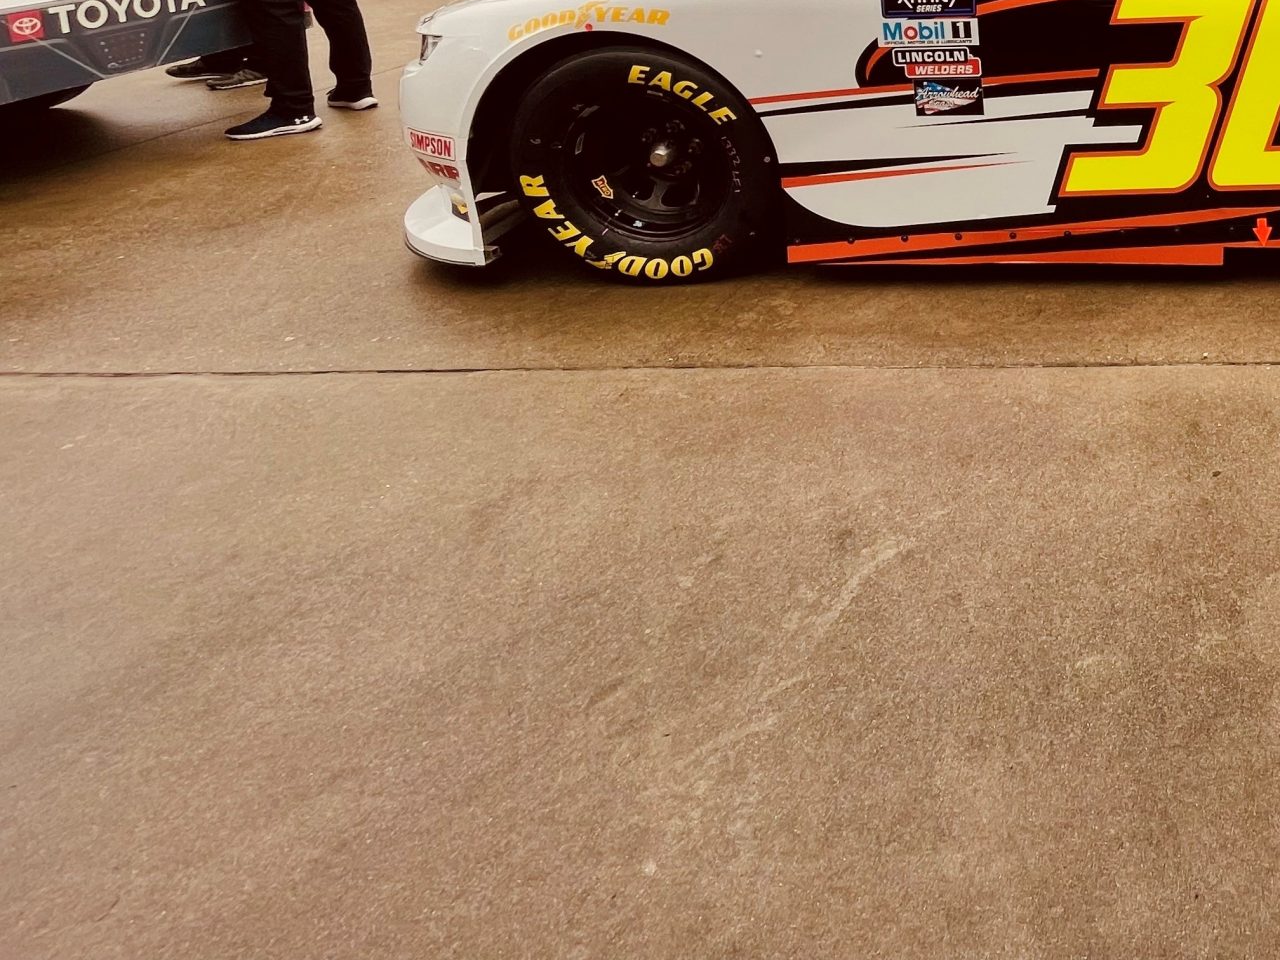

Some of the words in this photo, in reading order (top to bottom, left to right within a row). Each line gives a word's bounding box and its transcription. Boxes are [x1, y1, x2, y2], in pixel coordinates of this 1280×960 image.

[916, 4, 942, 13] SERIES
[508, 1, 671, 42] GOODYEAR
[882, 21, 945, 41] Mobil
[897, 51, 965, 63] LINCOLN
[914, 65, 974, 75] WELDERS
[627, 64, 738, 125] EAGLE
[409, 131, 452, 158] SIMPSON
[519, 174, 714, 280] GOODYEAR
